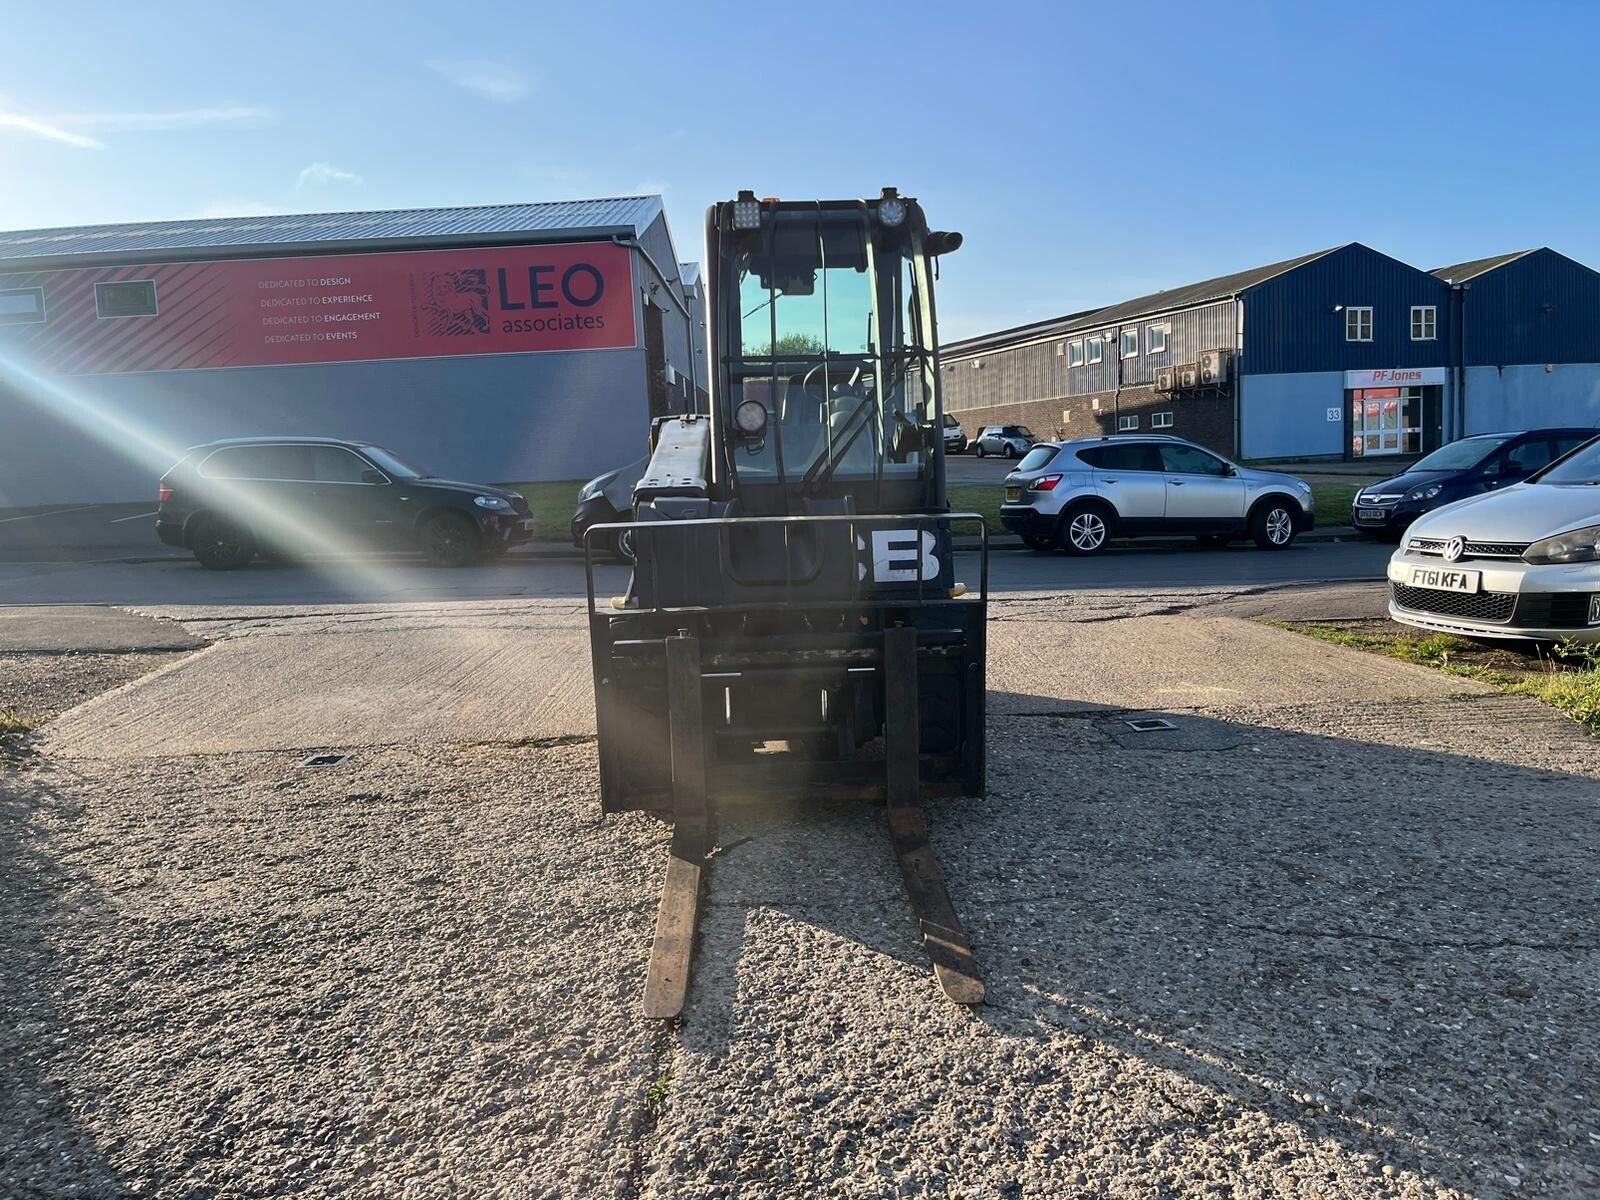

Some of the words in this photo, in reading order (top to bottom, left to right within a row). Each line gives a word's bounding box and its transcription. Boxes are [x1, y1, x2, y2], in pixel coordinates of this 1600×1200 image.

[258, 279, 305, 289] DEDICATED
[307, 279, 319, 287] TO
[320, 277, 352, 286] DESIGN
[497, 263, 604, 311] LEO
[260, 298, 307, 308] DEDICATED
[309, 297, 320, 305] TO
[321, 294, 373, 304] EXPERIENCE
[262, 315, 309, 326] DEDICATED
[310, 315, 322, 323] TO
[324, 312, 381, 322] ENGAGEMENT
[502, 313, 605, 333] associates
[264, 333, 311, 344] DEDICATED
[313, 333, 325, 341] TO
[326, 331, 358, 341] EVENTS
[1388, 370, 1423, 381] Jones
[1328, 409, 1340, 420] 33
